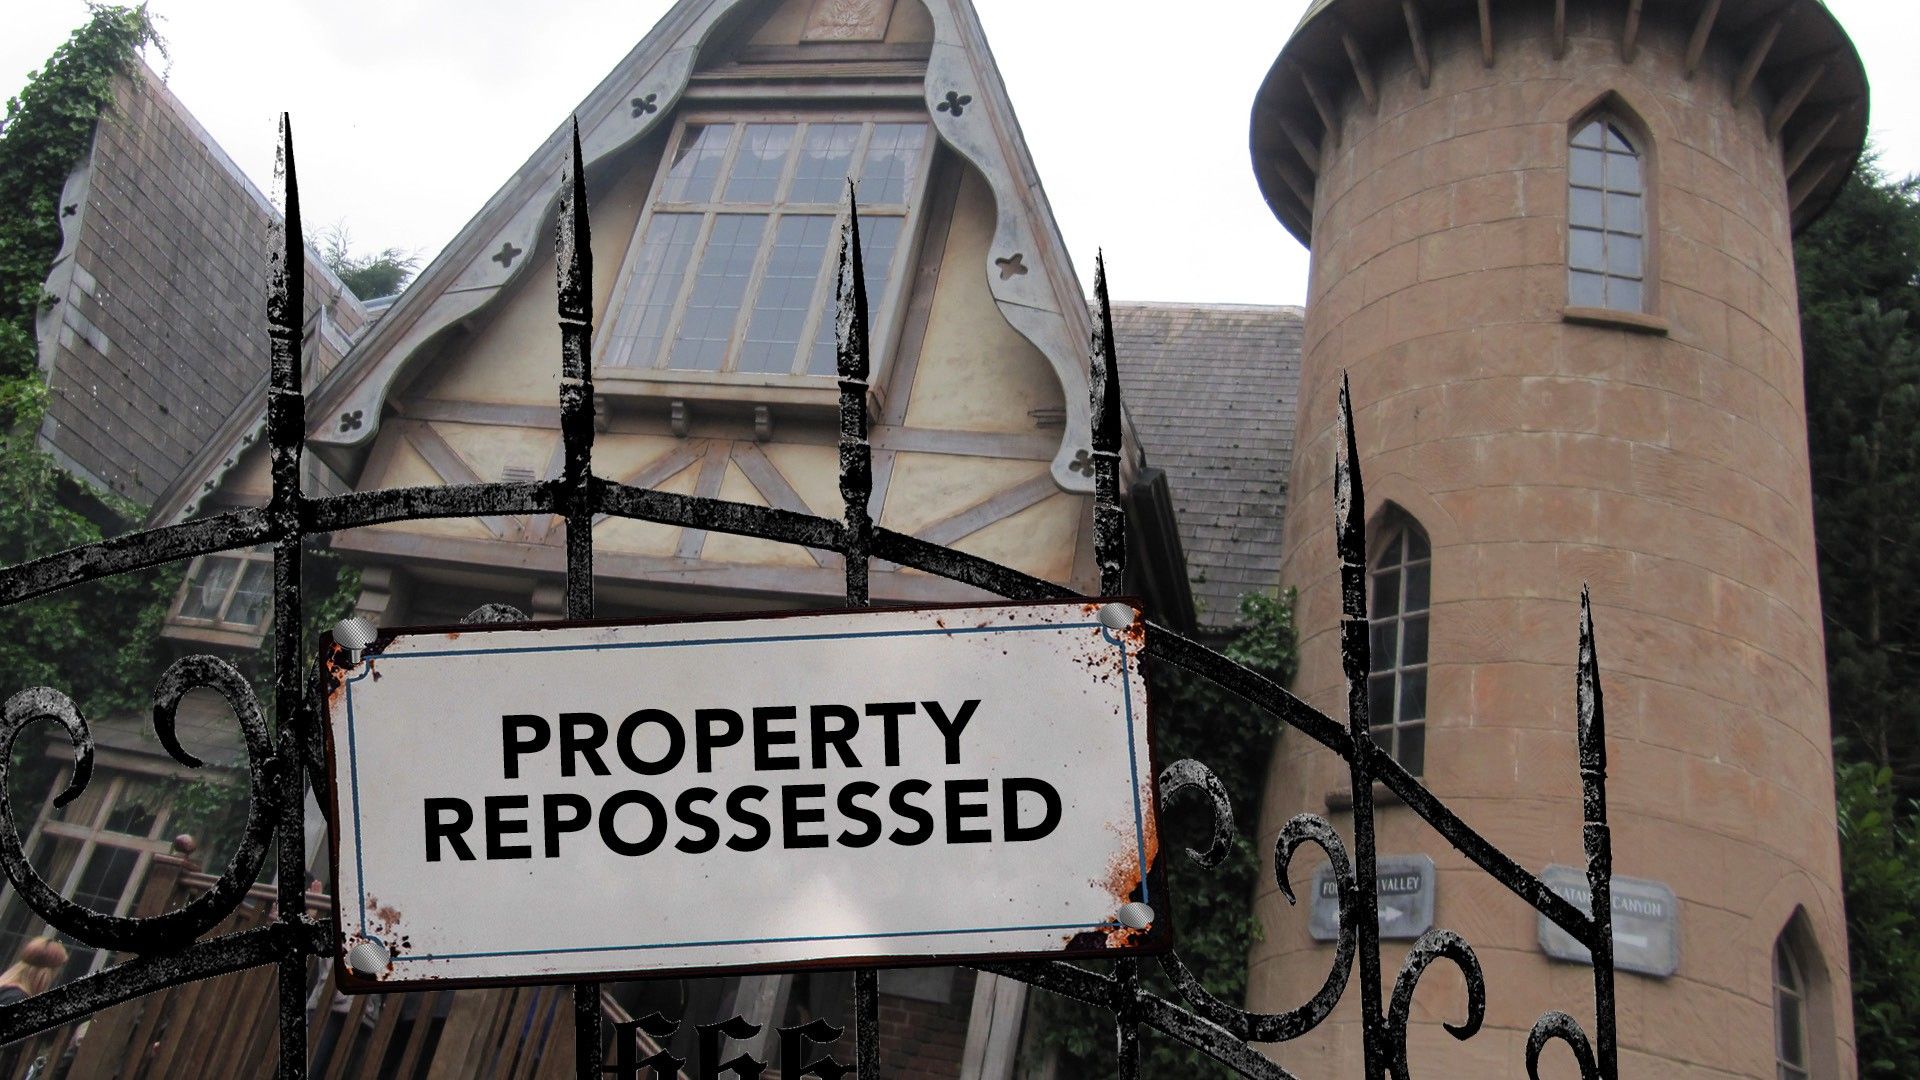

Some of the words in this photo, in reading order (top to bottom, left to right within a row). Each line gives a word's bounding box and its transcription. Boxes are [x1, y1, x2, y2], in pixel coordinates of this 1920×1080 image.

[501, 699, 982, 780] PROPERTY
[423, 777, 1063, 863] REPOSSESSED
[1381, 876, 1420, 891] VALLEY
[1612, 895, 1662, 916] CANYON
